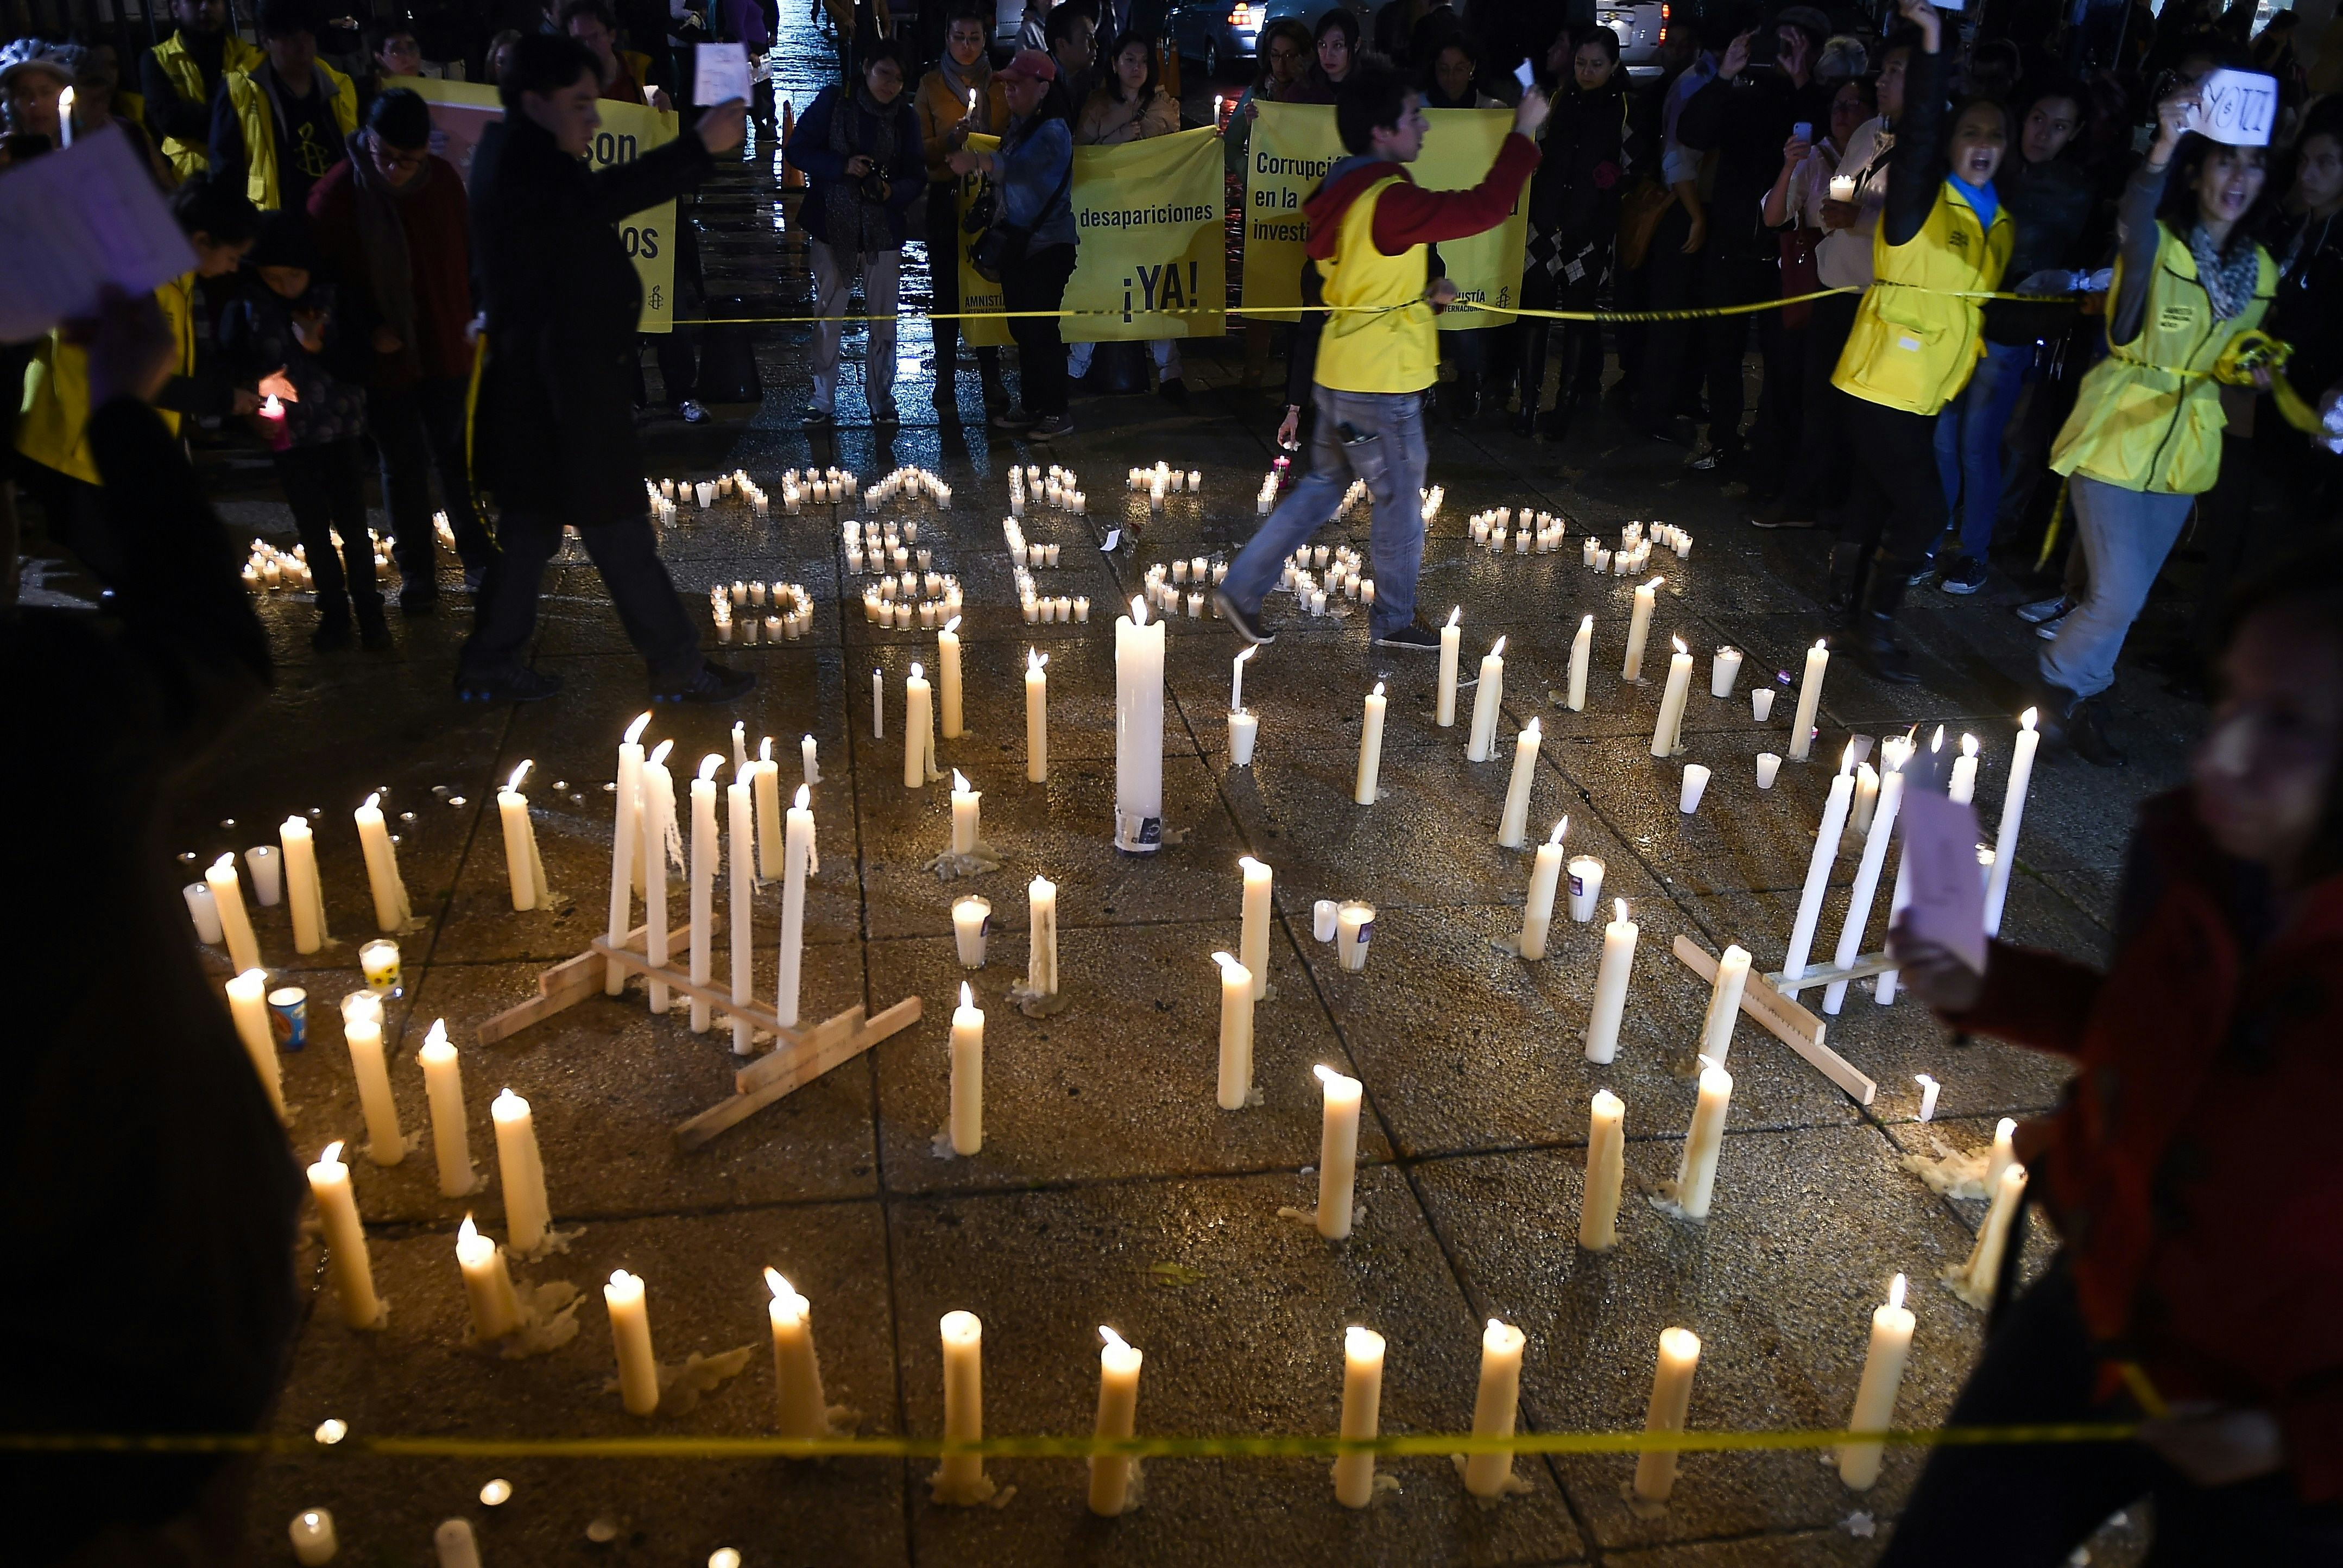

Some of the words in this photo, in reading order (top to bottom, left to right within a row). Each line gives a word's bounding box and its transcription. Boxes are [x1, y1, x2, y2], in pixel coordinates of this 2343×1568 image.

[1256, 152, 1341, 181] Corrupci
[1255, 191, 1275, 207] en
[1281, 187, 1298, 208] la
[1080, 204, 1212, 229] desapariciones
[965, 293, 1004, 308] AMNISTÍ
[1123, 261, 1197, 323] ¡YA!
